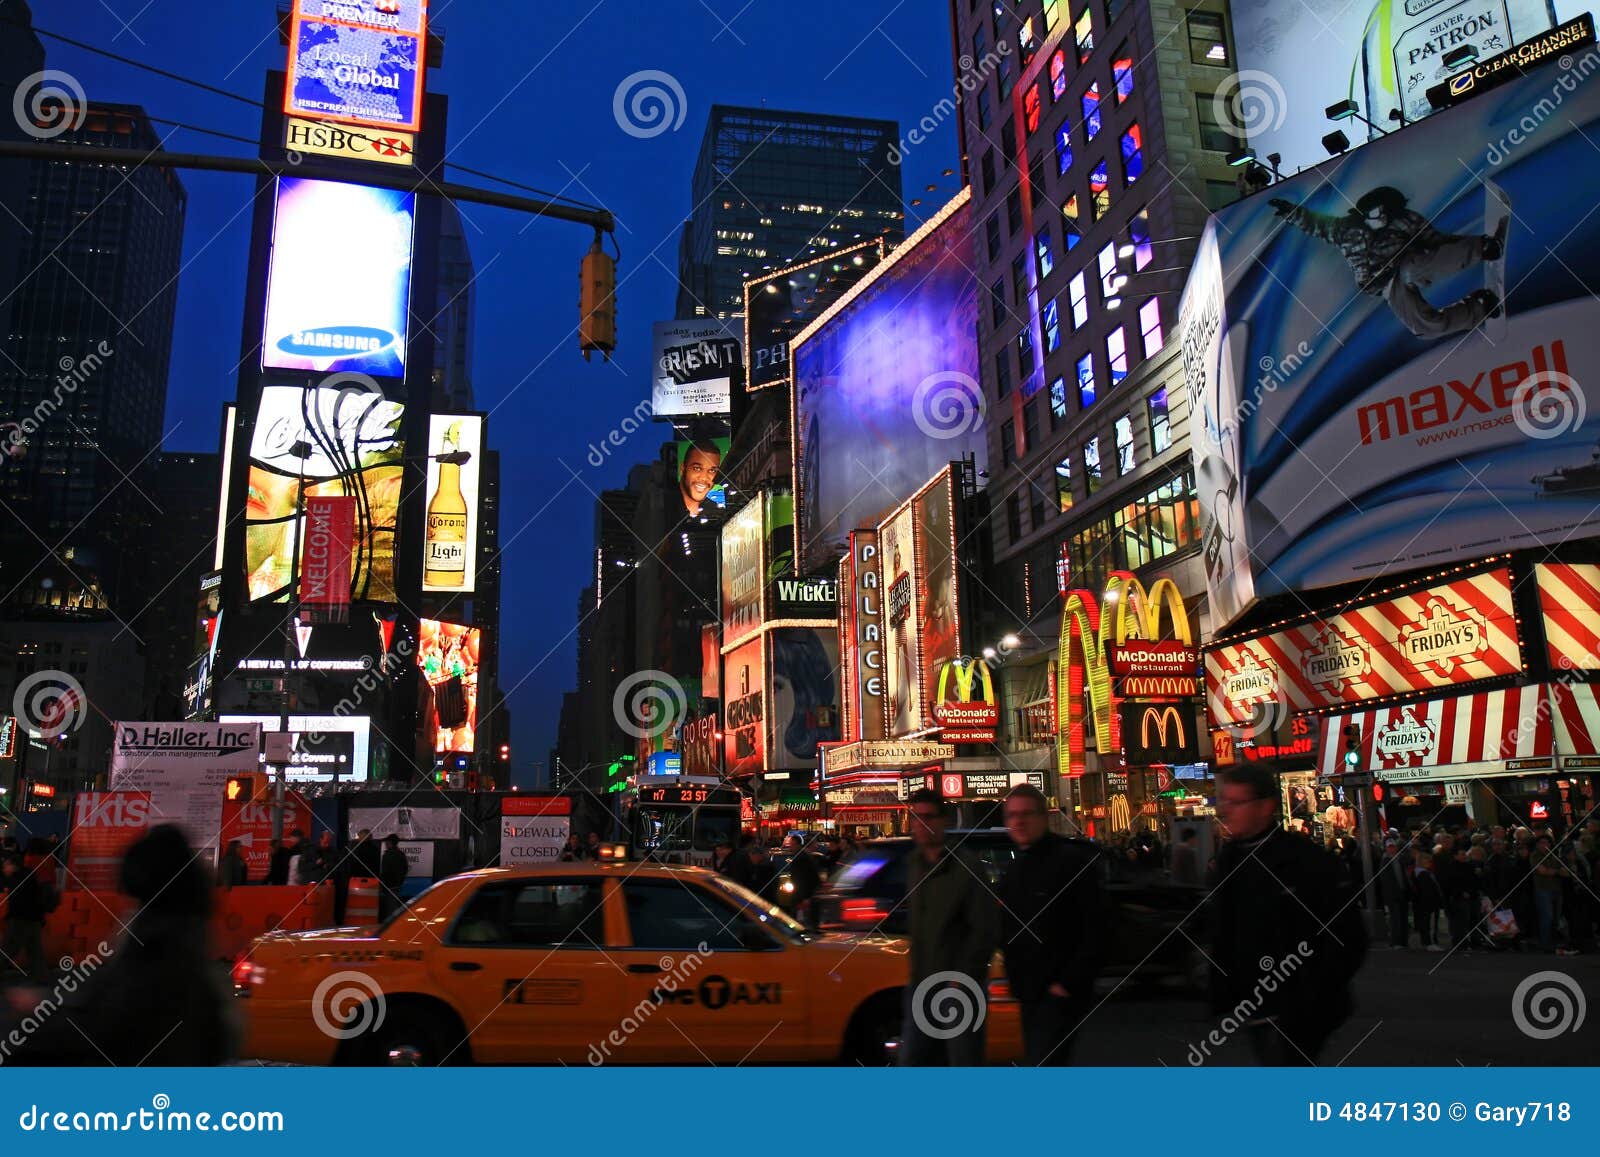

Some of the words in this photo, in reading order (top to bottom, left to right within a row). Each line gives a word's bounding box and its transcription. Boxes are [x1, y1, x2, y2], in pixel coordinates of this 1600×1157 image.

[322, 4, 401, 29] PREMIER
[1430, 14, 1464, 35] SILVER
[1408, 12, 1493, 66] PATRÓN
[1518, 30, 1587, 66] SPECTACOLOR
[313, 45, 368, 66] Local
[335, 65, 400, 89] Global
[290, 125, 367, 152] HSBC
[292, 331, 381, 351] SAMSUNG
[667, 344, 735, 371] RENT
[1357, 339, 1572, 446] maxell
[430, 516, 466, 530] Corona
[308, 504, 332, 599] WELCOME
[431, 543, 463, 560] Light
[862, 545, 881, 697] PALACE
[1411, 626, 1474, 653] FRIDAY'S
[1117, 650, 1195, 663] McDonald's
[1311, 651, 1360, 675] FRIDAY'S
[1130, 663, 1183, 672] Restaurant
[1230, 673, 1270, 693] FRIDAY'S
[937, 708, 996, 717] McDonald's
[217, 728, 254, 746] Inc.
[1385, 731, 1427, 747] FRIDAY'S
[120, 750, 167, 758] construction
[169, 750, 217, 759] management
[866, 748, 907, 757] LEGALLY
[911, 747, 951, 757] BLONDE
[1216, 737, 1231, 758] 47
[302, 753, 347, 763] Coverae
[277, 765, 319, 775] merica
[985, 774, 1008, 782] SQUARE
[1377, 770, 1409, 781] Restaurant
[1418, 769, 1430, 778] Bar
[681, 790, 693, 800] 23
[695, 790, 708, 800] ST
[77, 792, 149, 827] tkts
[503, 827, 568, 838] SIDEWALK
[510, 847, 559, 857] CLOSED
